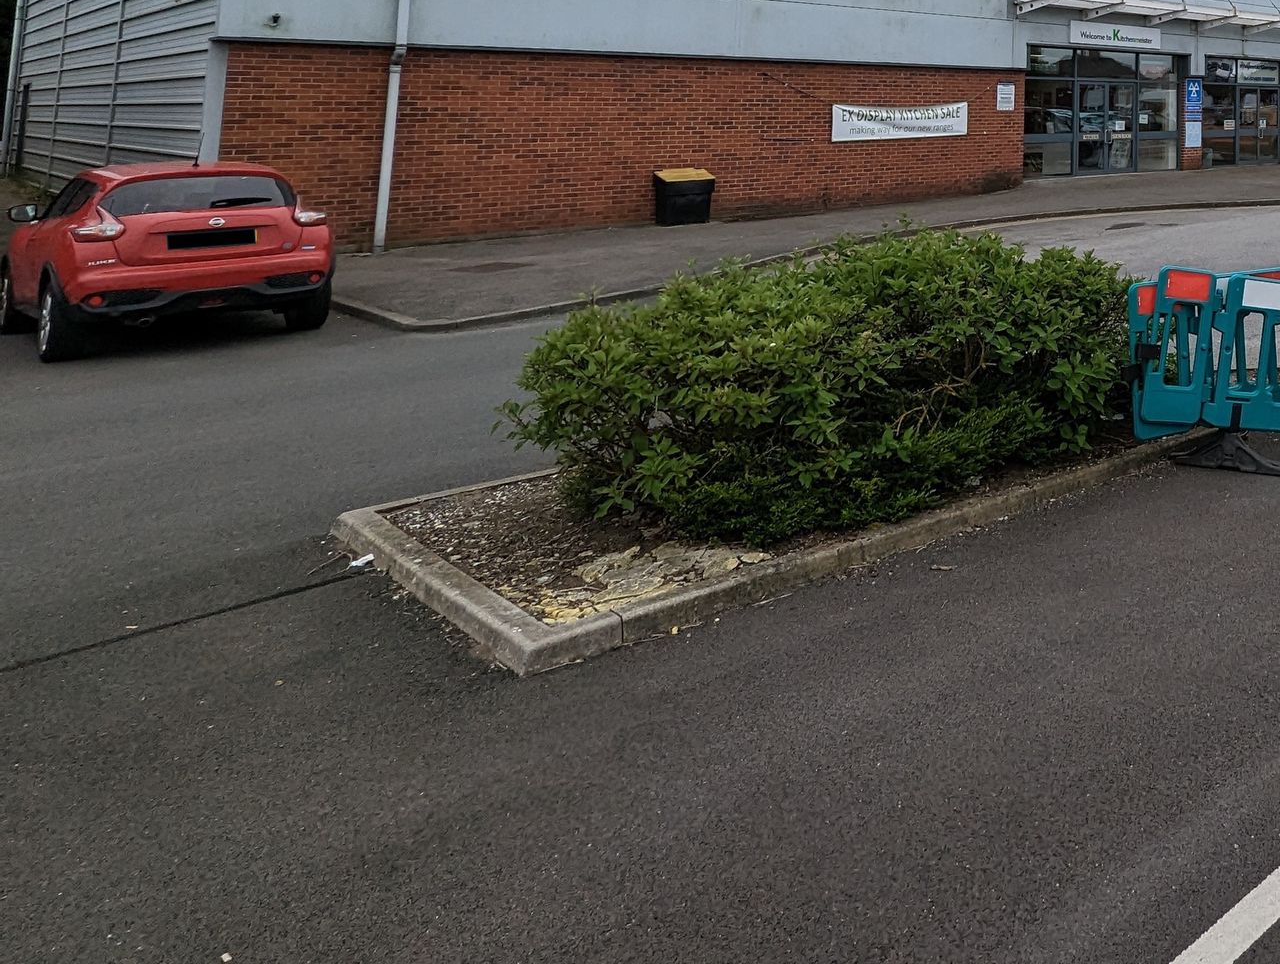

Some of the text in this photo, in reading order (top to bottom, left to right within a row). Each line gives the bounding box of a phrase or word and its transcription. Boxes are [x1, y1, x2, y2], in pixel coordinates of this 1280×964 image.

[1080, 30, 1106, 40] Welcome
[1112, 28, 1153, 44] Kitchenmeister
[842, 106, 961, 122] EX DISPLAY KITCHEN SALE
[849, 125, 876, 135] making
[877, 125, 891, 134] way
[892, 124, 902, 133] for
[917, 124, 932, 132] new
[932, 123, 954, 133] ranges
